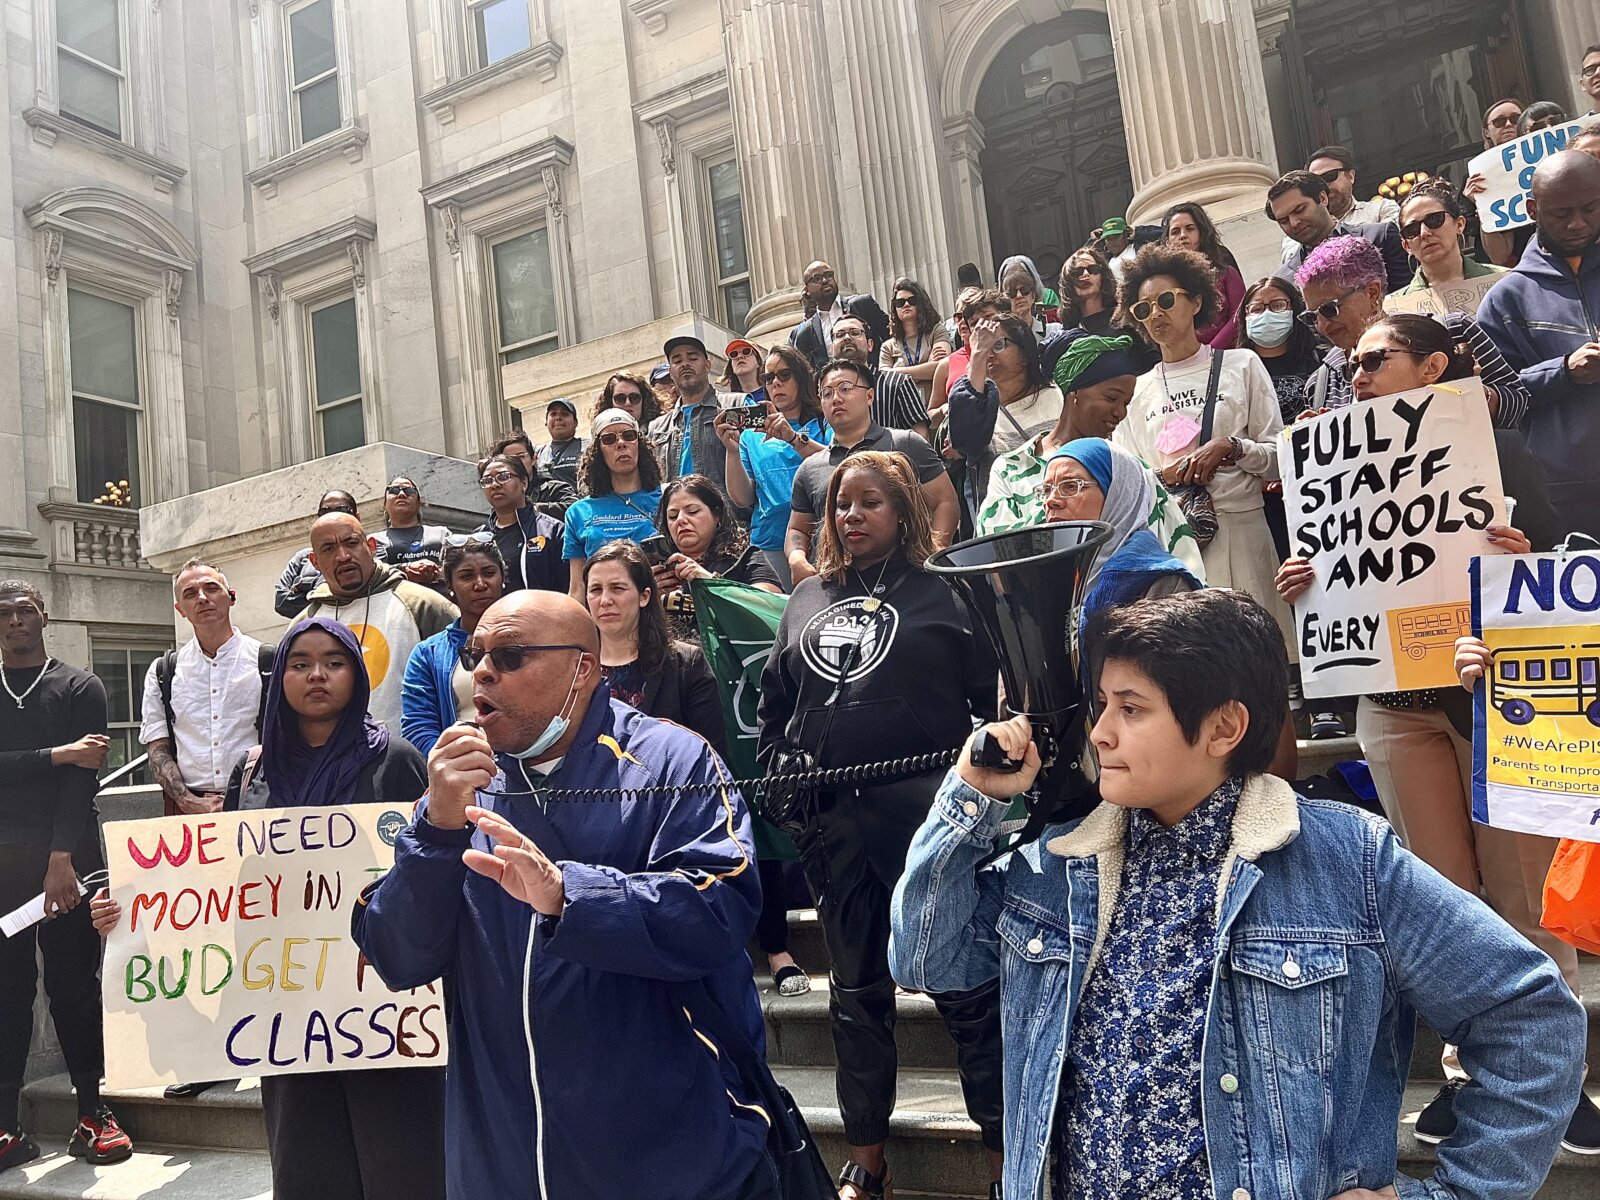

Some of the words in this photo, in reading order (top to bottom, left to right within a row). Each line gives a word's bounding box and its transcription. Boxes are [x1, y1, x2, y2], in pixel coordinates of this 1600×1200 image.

[1146, 410, 1156, 421] LA
[1162, 393, 1224, 414] RESISTAE
[1170, 389, 1196, 401] VIVE
[1291, 393, 1435, 480] FULLY
[1300, 445, 1451, 515] STAFF
[1296, 486, 1494, 558] SCHOOLS
[397, 550, 428, 559] Cildren's
[1325, 541, 1436, 592] AND
[1503, 555, 1600, 613] NO
[1301, 613, 1380, 657] EVERY
[1492, 756, 1540, 771] Parents
[1544, 764, 1556, 773] to
[1560, 765, 1600, 777] Impro
[127, 822, 225, 869] WE
[238, 813, 357, 857] NEED
[130, 874, 282, 932] MONEY
[125, 937, 342, 1003] BUDGET
[225, 1003, 440, 1066] CLASSES
